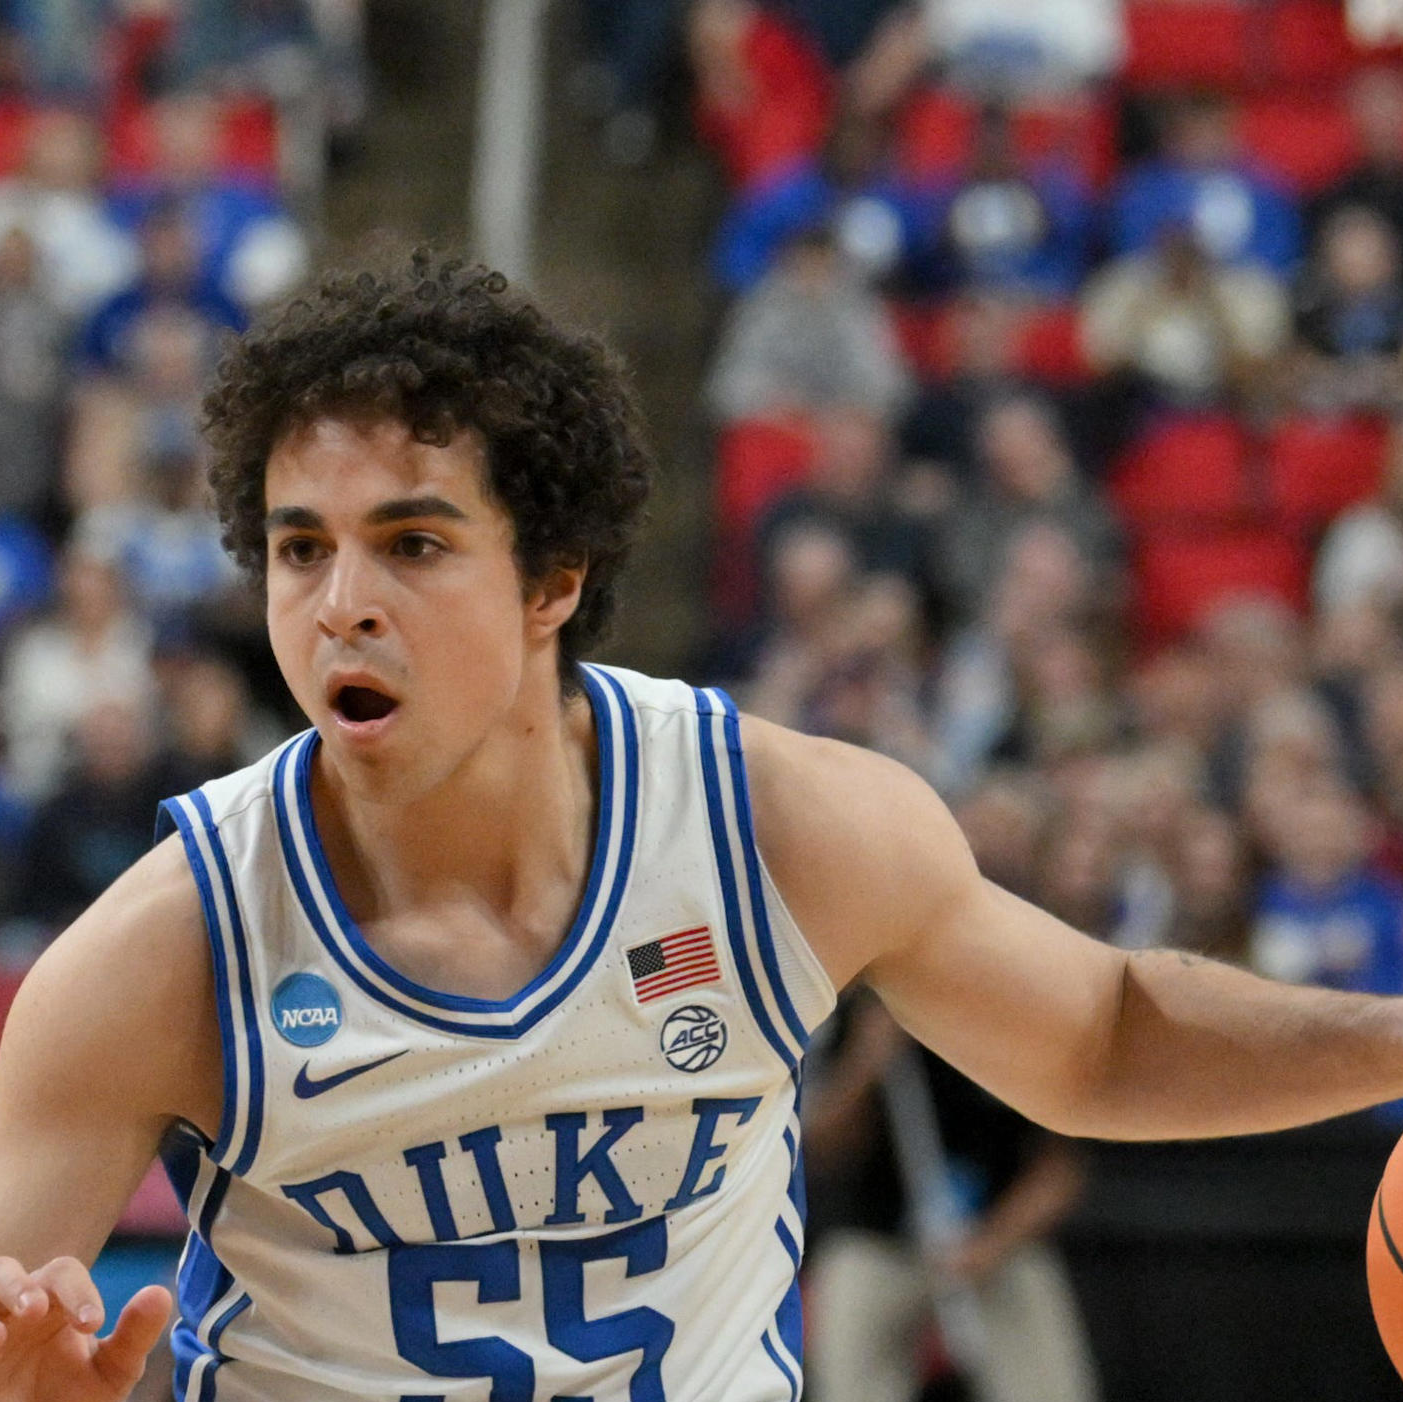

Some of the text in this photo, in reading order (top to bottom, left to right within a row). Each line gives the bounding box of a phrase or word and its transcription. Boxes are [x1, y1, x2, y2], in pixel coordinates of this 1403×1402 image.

[281, 1007, 339, 1029] NCAA
[669, 1019, 720, 1049] ACC
[280, 1095, 763, 1255] DUKE
